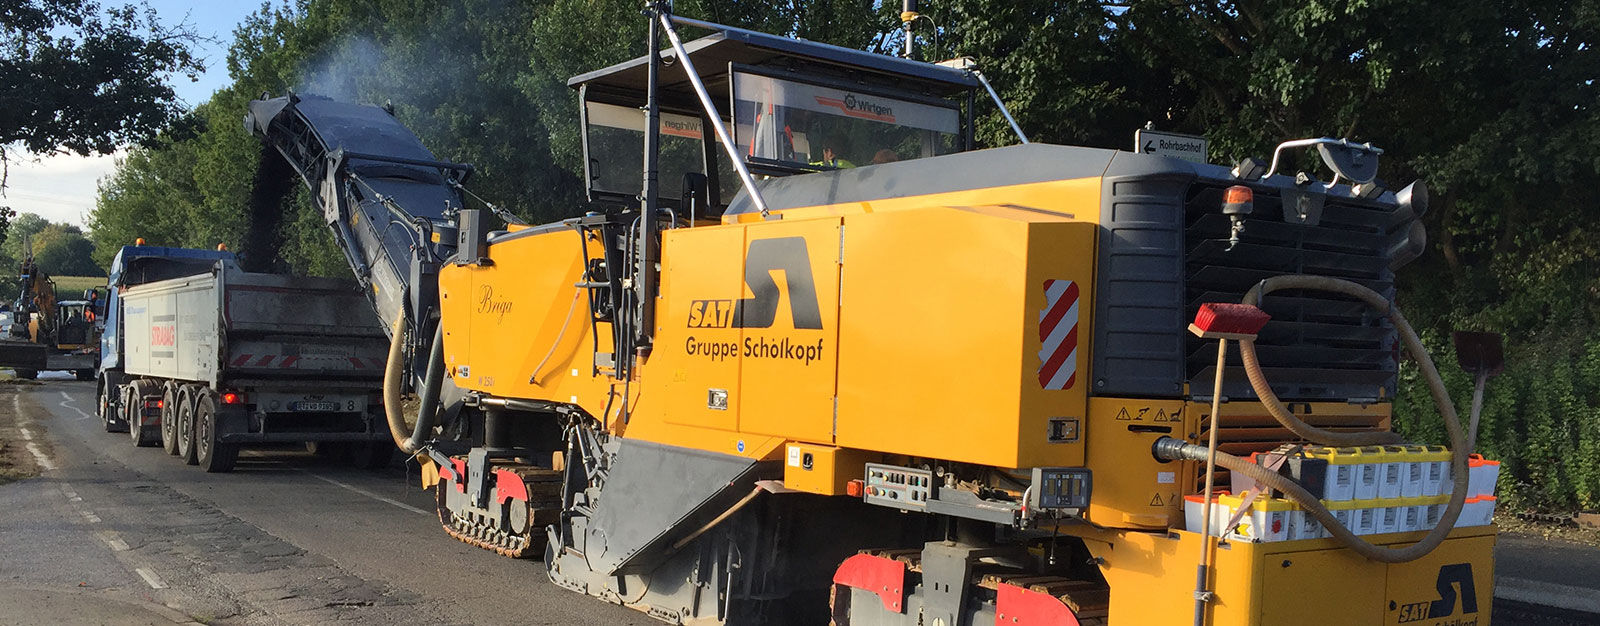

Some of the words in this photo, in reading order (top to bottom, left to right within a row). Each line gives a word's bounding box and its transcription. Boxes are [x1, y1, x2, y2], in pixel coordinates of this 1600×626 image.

[856, 101, 893, 116] Wirtgen
[1159, 139, 1202, 153] Rohrbachhof
[478, 283, 513, 326] Briga
[687, 299, 732, 329] SAT
[151, 324, 175, 346] STRABAG
[686, 336, 738, 361] Gruppe
[347, 400, 355, 411] 8
[1398, 601, 1430, 624] SAT
